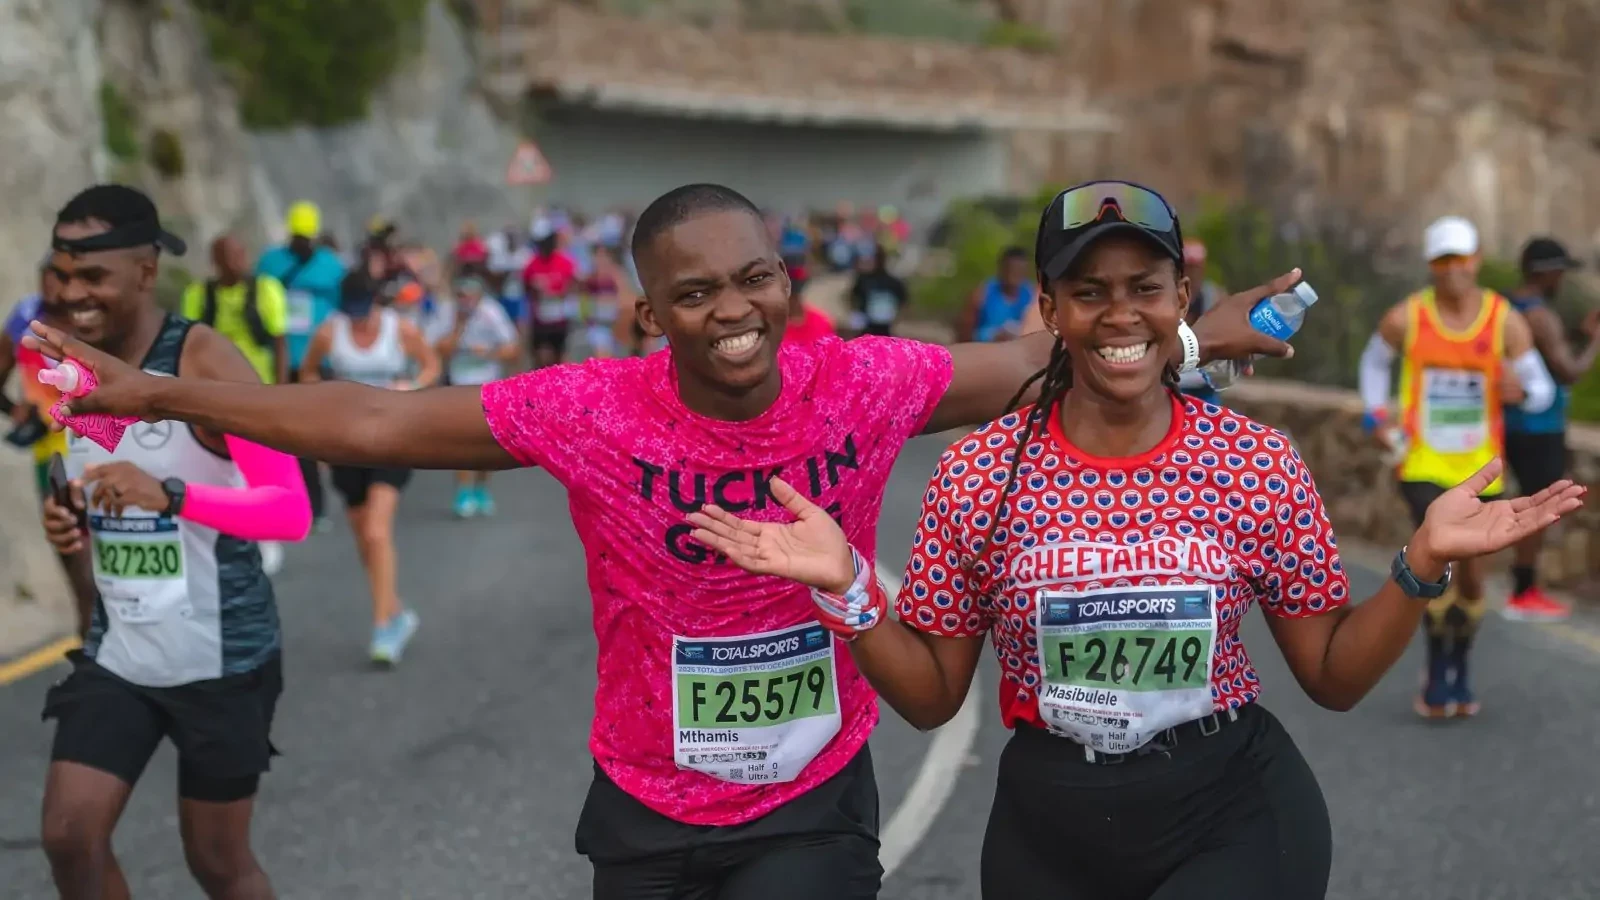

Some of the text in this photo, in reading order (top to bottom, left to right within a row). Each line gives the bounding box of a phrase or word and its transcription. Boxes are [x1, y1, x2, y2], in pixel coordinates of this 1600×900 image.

[632, 432, 860, 513] TUCK IN
[1015, 539, 1227, 583] CHEETAHS AC
[1078, 598, 1176, 617] TOTALSPORTS
[1170, 621, 1212, 629] MARATHON
[711, 636, 800, 660] TOTALSPORTS
[1046, 685, 1118, 706] Masibulele
[679, 730, 739, 743] Mthamis
[1108, 732, 1126, 741] Half
[1108, 742, 1130, 750] Ultra
[748, 762, 778, 771] Half 0
[772, 771, 778, 779] 2
